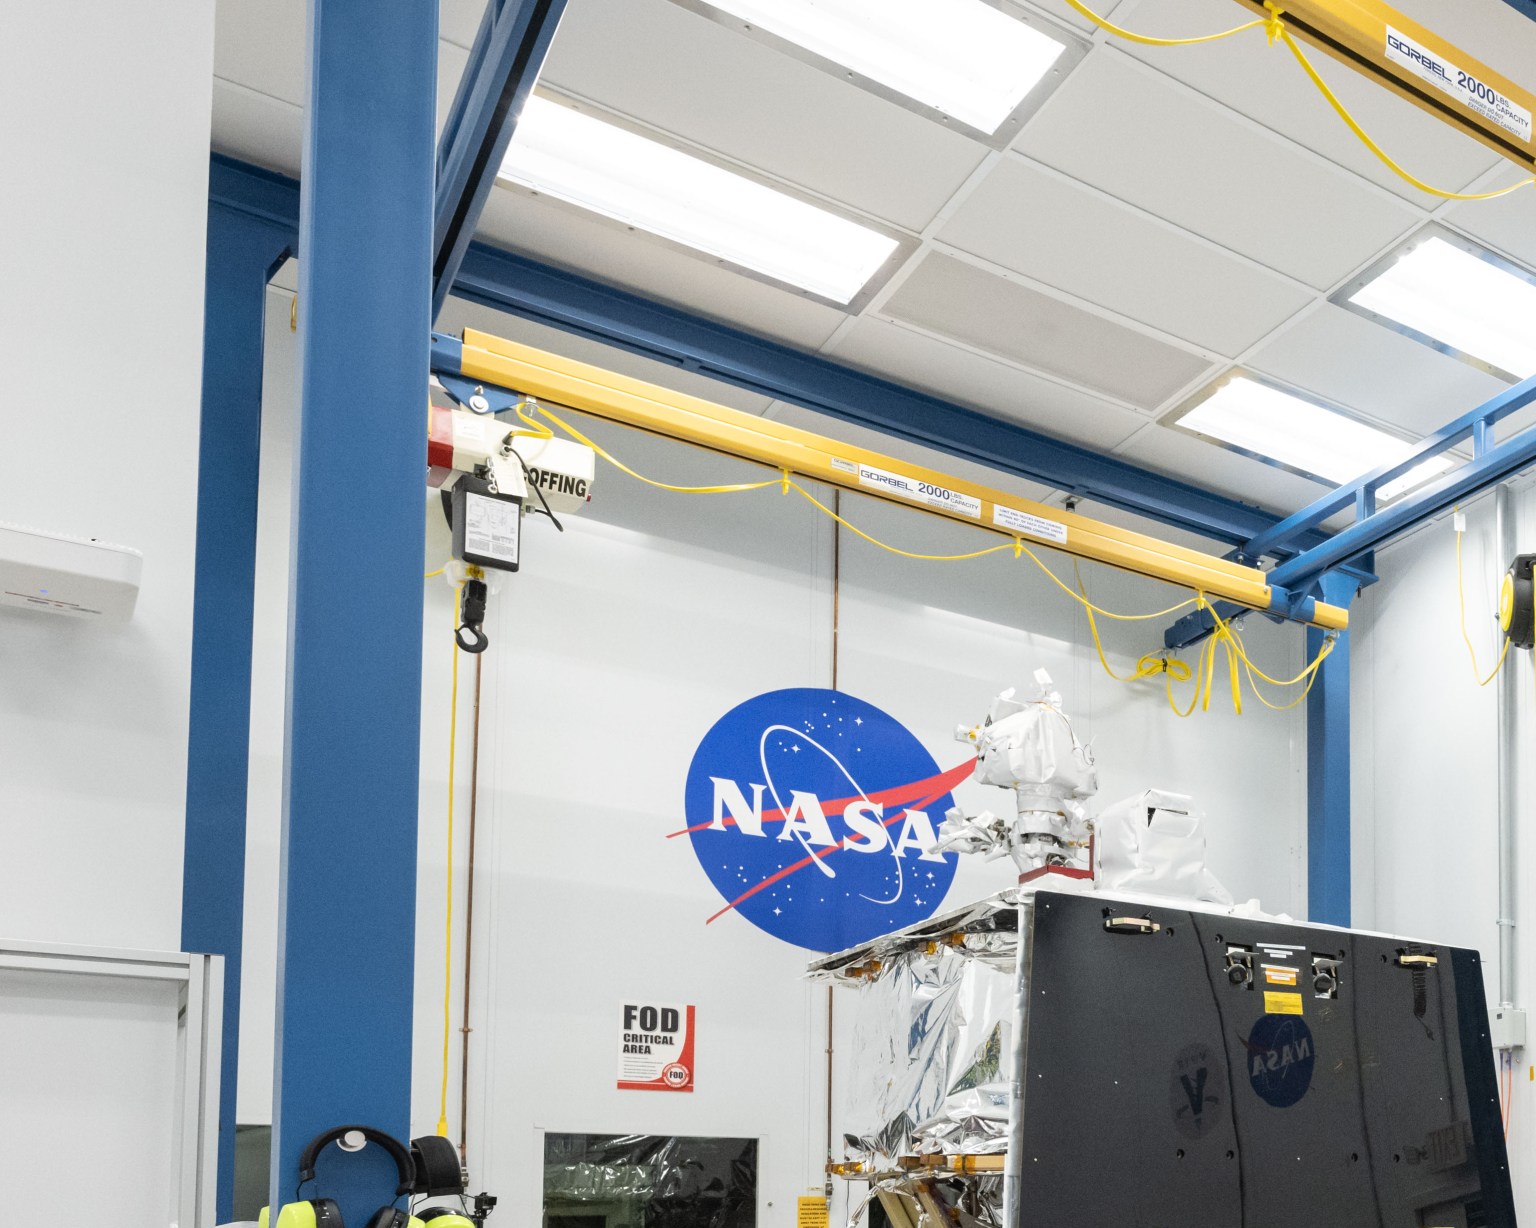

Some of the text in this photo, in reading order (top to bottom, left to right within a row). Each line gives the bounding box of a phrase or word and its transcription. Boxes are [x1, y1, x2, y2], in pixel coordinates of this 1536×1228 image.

[1388, 35, 1452, 82] GORBEL
[1458, 71, 1495, 105] 2000
[1495, 94, 1511, 108] LBS.
[1495, 104, 1528, 127] CAPACITY
[861, 470, 913, 492] GORBEL
[918, 483, 950, 500] 2000
[951, 499, 978, 510] CAPACITY
[707, 776, 948, 863] NASA
[624, 1005, 679, 1032] FOD
[623, 1044, 651, 1054] AREA
[624, 1033, 674, 1045] CRITICAL
[670, 1071, 683, 1079] FOD
